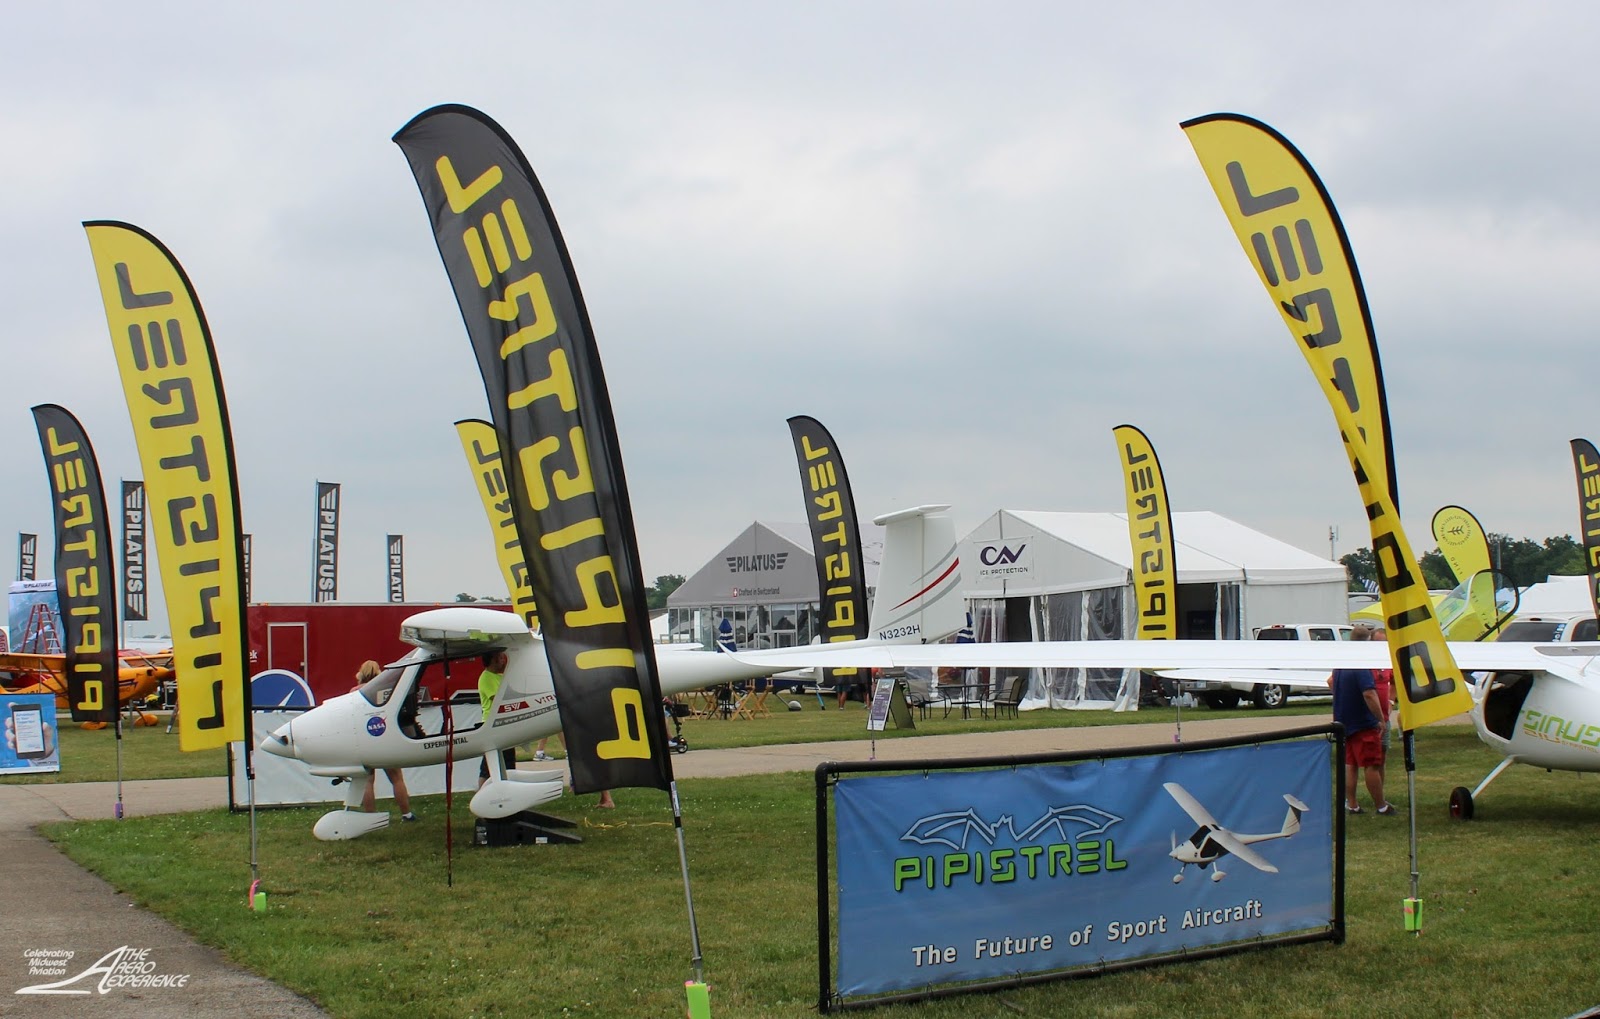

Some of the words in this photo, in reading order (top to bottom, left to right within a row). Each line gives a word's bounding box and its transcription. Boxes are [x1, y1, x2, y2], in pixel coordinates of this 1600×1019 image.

[126, 510, 144, 592] PILATUS
[319, 511, 336, 591] PILATUS
[736, 553, 776, 573] PILATUS
[991, 567, 1028, 575] PROTECTION
[738, 588, 752, 596] Crafted
[758, 587, 780, 595] Switzerland
[879, 624, 921, 640] N3232H
[368, 723, 386, 731] NASA
[424, 737, 468, 749] EXPERIMNTAL
[894, 840, 1127, 892] PIPISTREL
[912, 946, 956, 967] The
[975, 936, 1052, 960] Future
[1069, 926, 1092, 947] of
[1107, 914, 1166, 942] Sport
[1182, 899, 1262, 930] Aircraft
